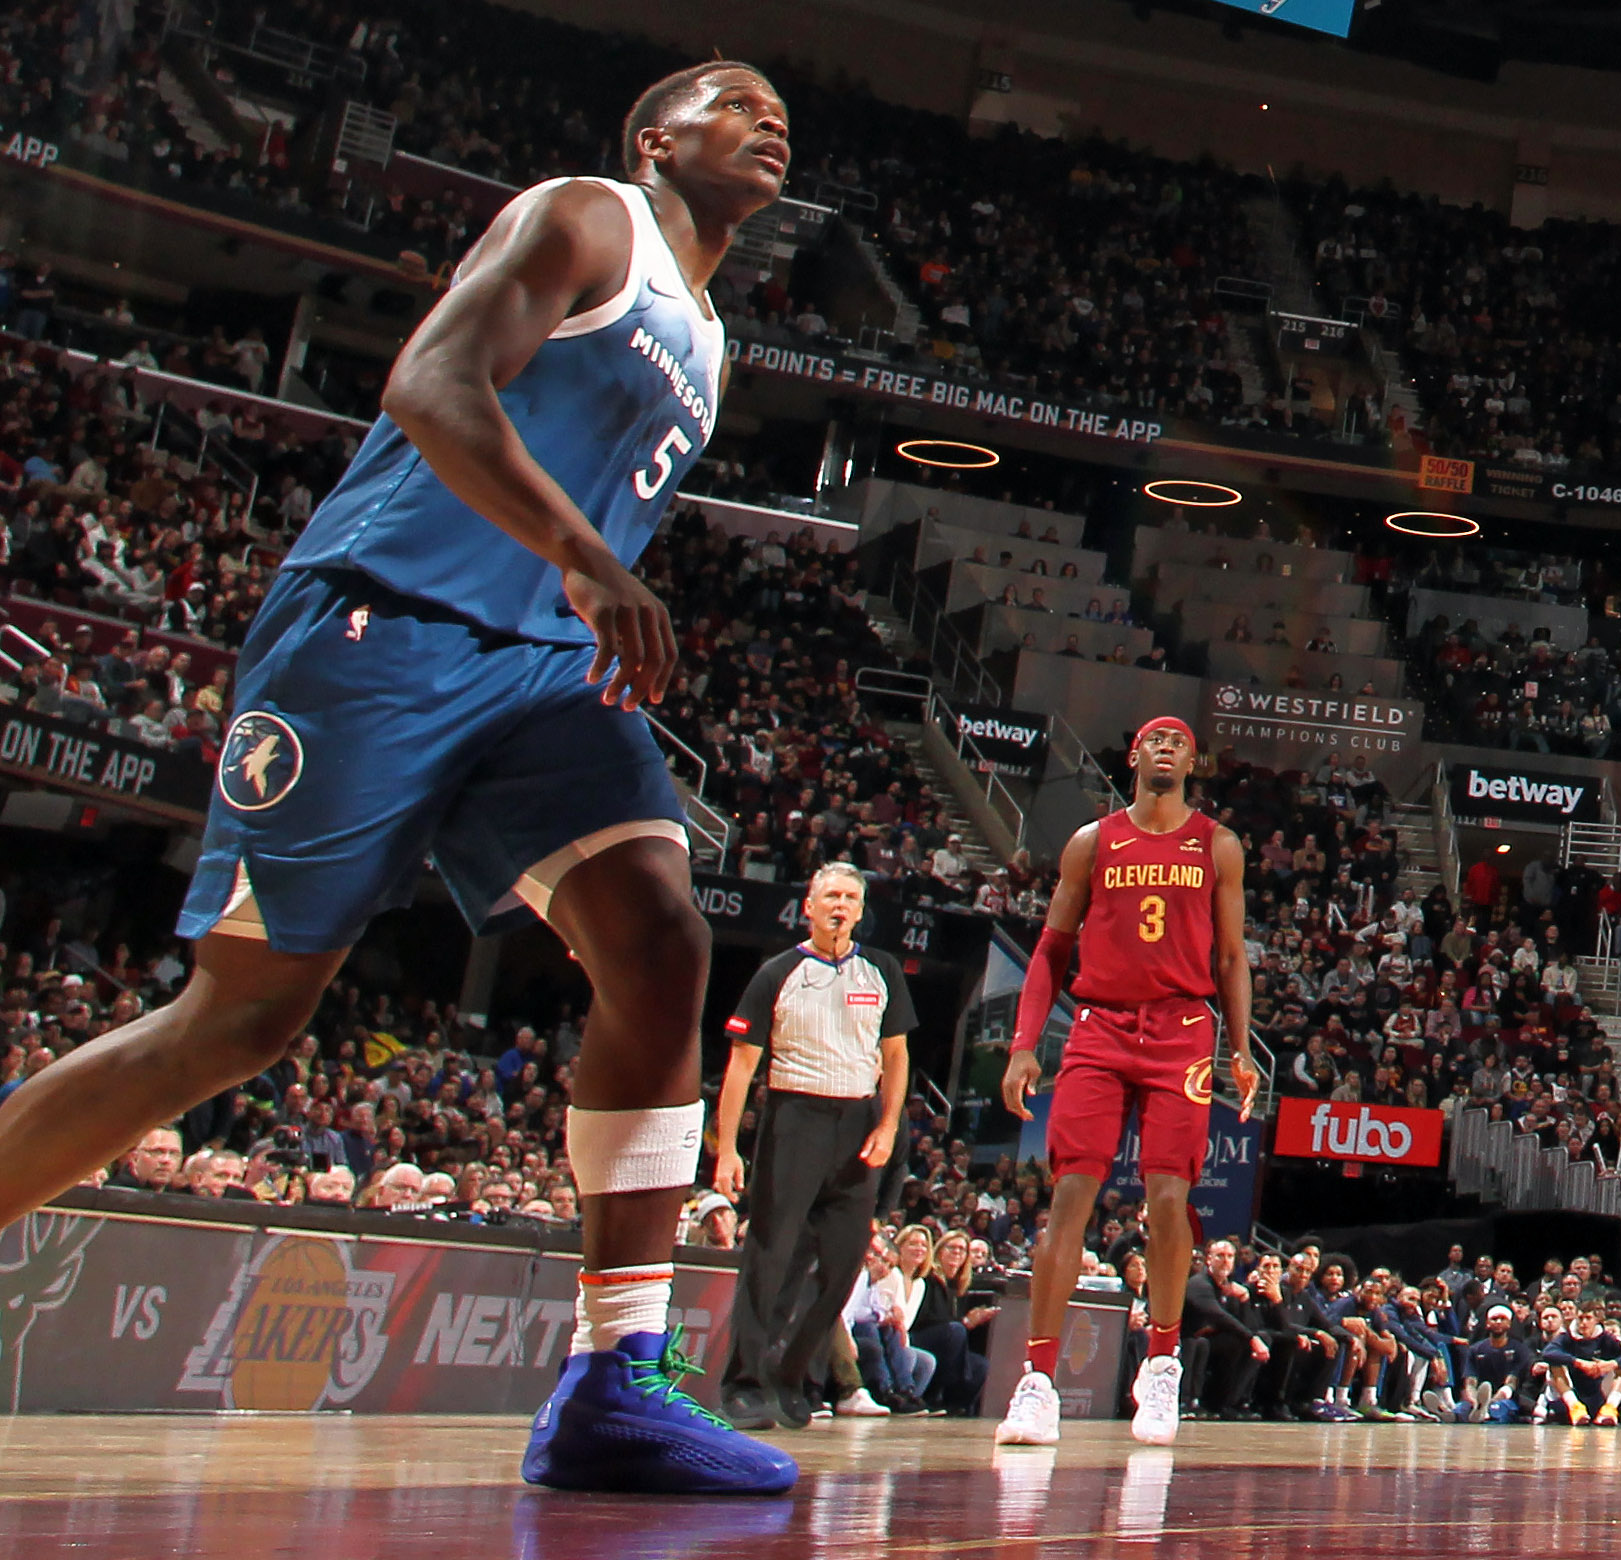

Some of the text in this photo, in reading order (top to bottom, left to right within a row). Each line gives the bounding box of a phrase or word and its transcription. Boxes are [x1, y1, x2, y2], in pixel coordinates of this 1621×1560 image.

[6, 130, 59, 167] APP
[748, 346, 836, 382] POINTS
[864, 366, 924, 400] FREE
[931, 380, 970, 409] BIG
[976, 391, 1024, 421] MAC
[1030, 401, 1060, 428] ON
[1066, 407, 1109, 436] THE
[1114, 419, 1162, 443] APP
[631, 425, 694, 502] 5
[958, 713, 1038, 748] betway
[1249, 692, 1405, 725] WESTFIELD
[1, 722, 156, 795] ON THE APP
[1215, 721, 1401, 753] CHAMPIONS CLUB
[1467, 769, 1584, 814] betway
[1104, 864, 1204, 890] CLEVELAND
[902, 927, 930, 953] 44
[1138, 894, 1167, 943] 3
[681, 1131, 698, 1150] 5
[1310, 1103, 1413, 1158] fubo
[111, 1284, 169, 1342] VS
[203, 1274, 382, 1391] LAKERS
[414, 1293, 573, 1366] NEXT
